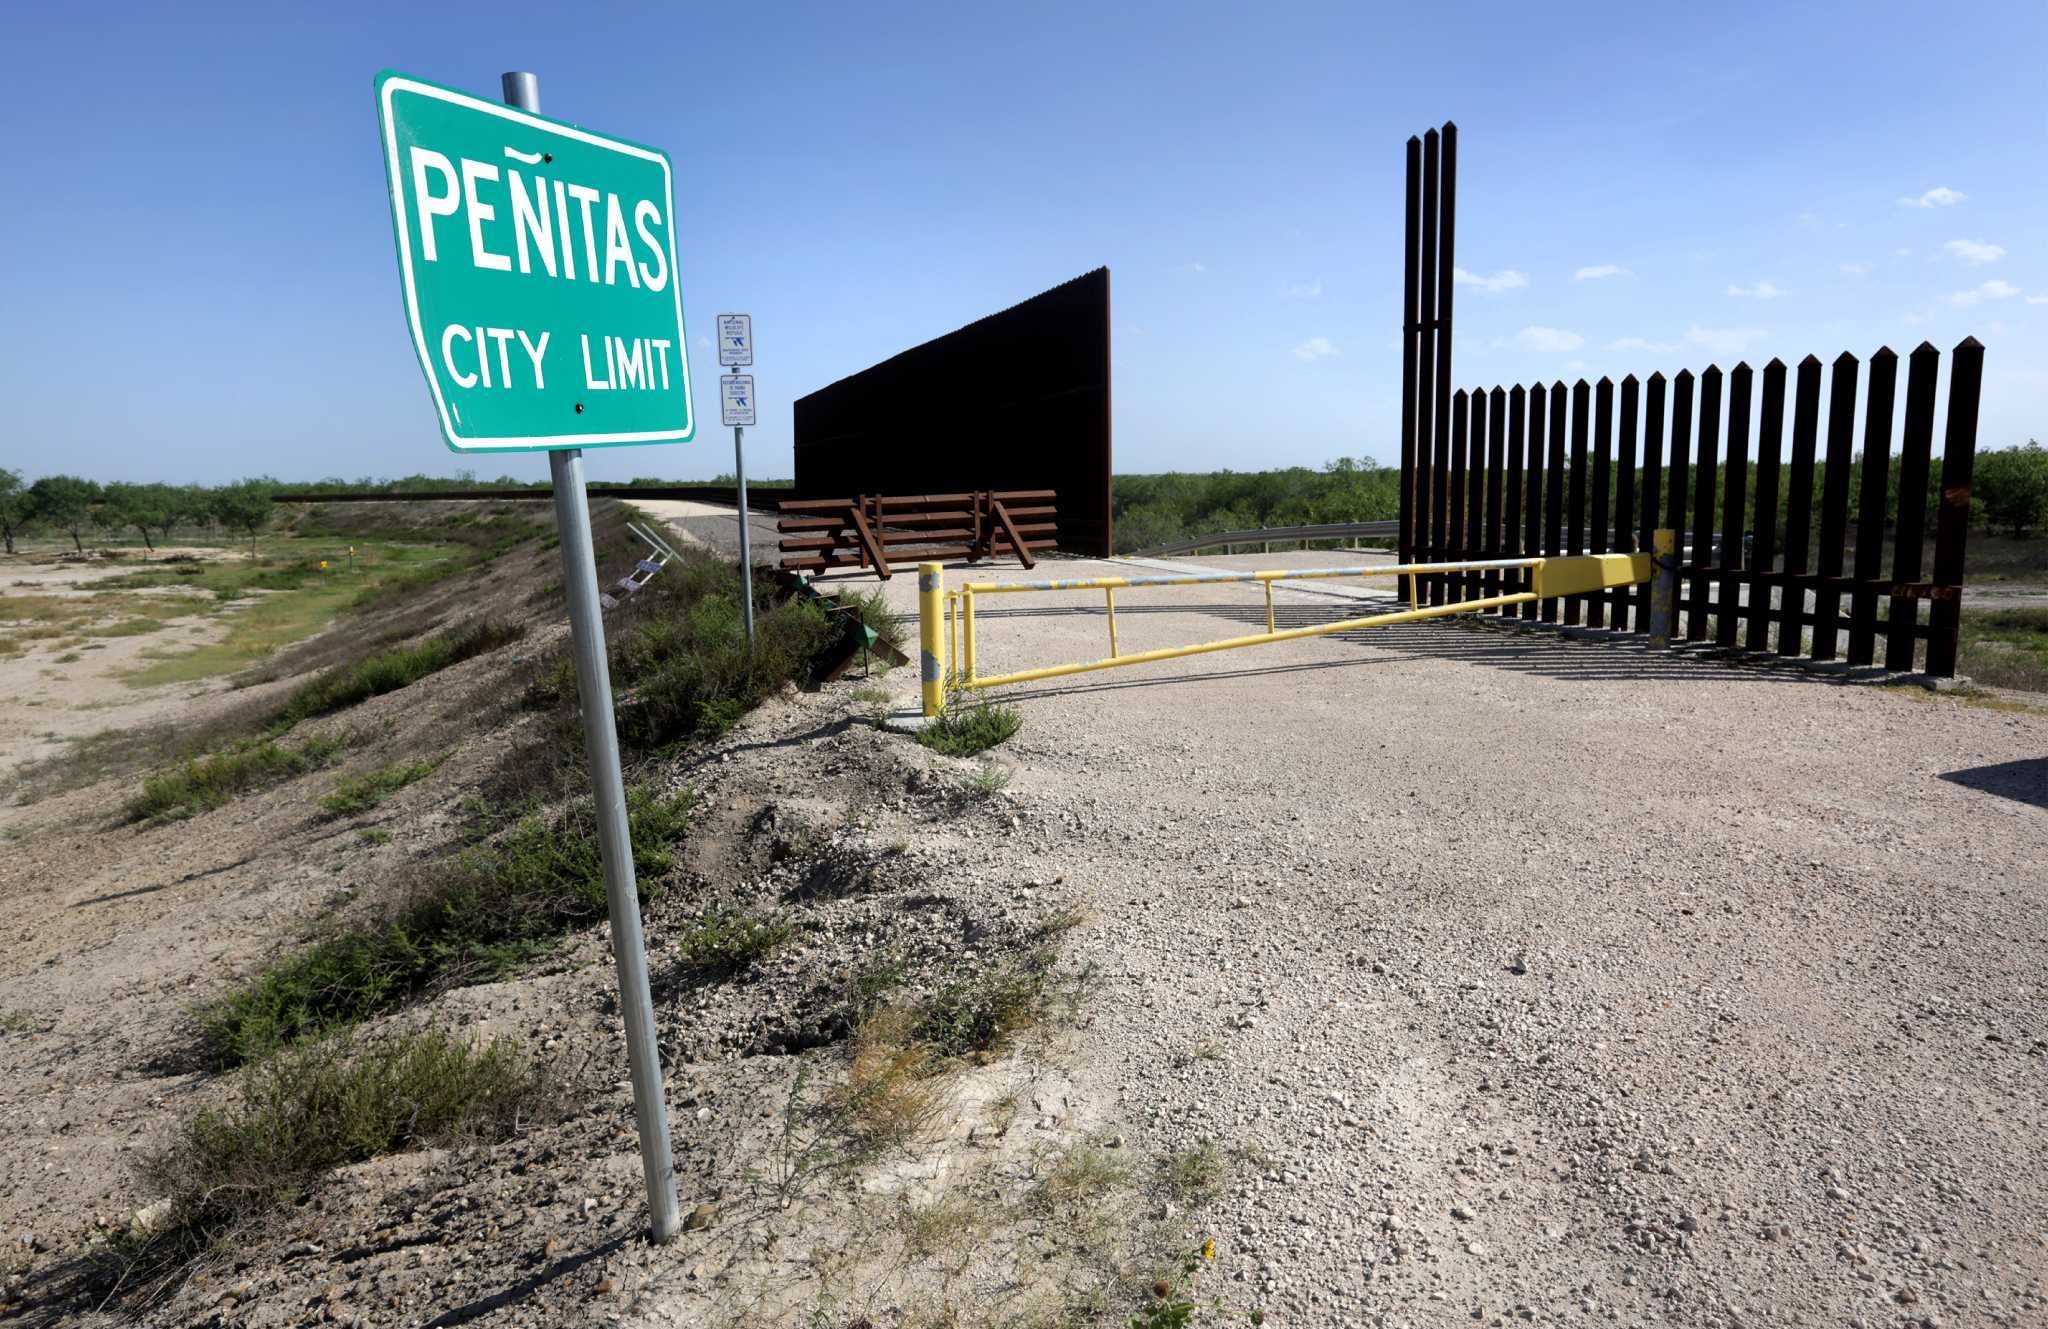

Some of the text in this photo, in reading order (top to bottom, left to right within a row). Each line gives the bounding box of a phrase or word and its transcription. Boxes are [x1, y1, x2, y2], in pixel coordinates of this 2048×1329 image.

[410, 146, 668, 292] PEÑITAS
[442, 324, 671, 390] CITY LIMIT
